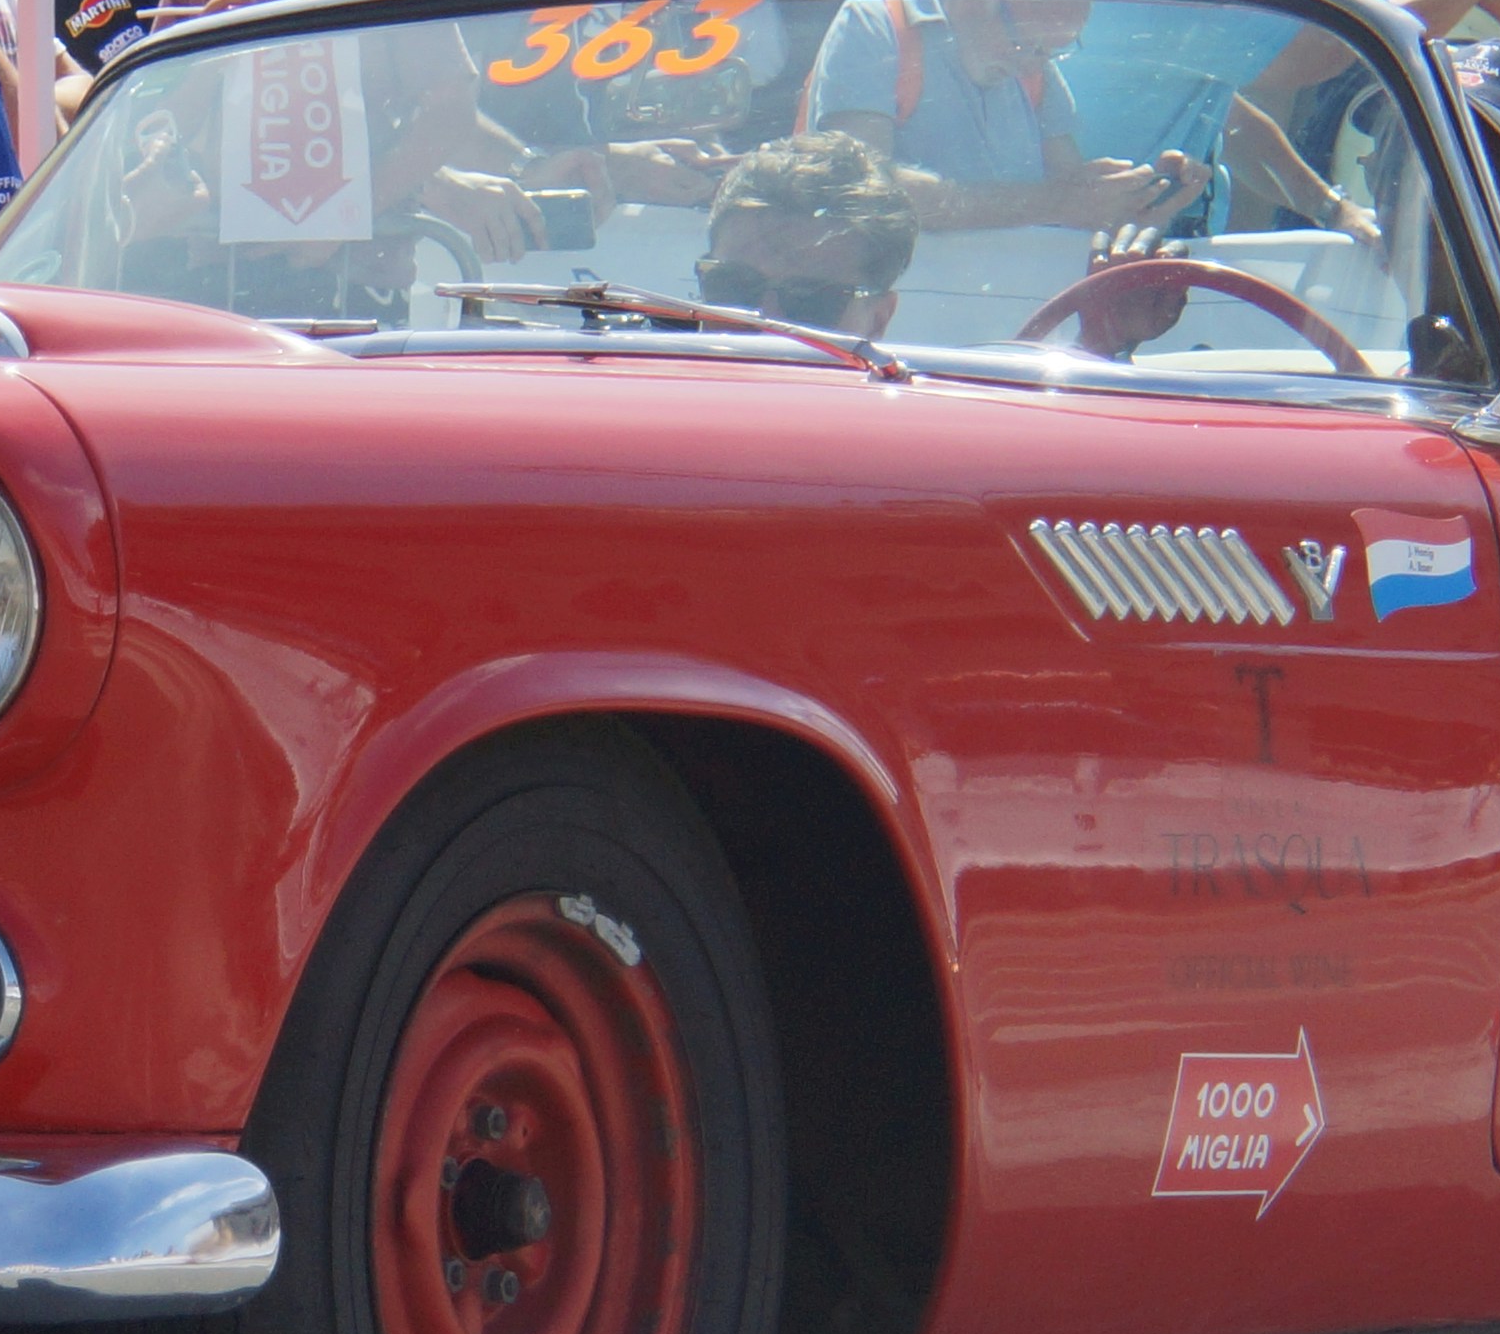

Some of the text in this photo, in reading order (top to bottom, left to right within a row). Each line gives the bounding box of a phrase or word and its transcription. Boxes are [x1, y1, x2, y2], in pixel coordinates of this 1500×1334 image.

[1161, 832, 1370, 915] TRASQUA
[1196, 1082, 1276, 1118] 1000
[1176, 1134, 1270, 1170] MIGLIA
